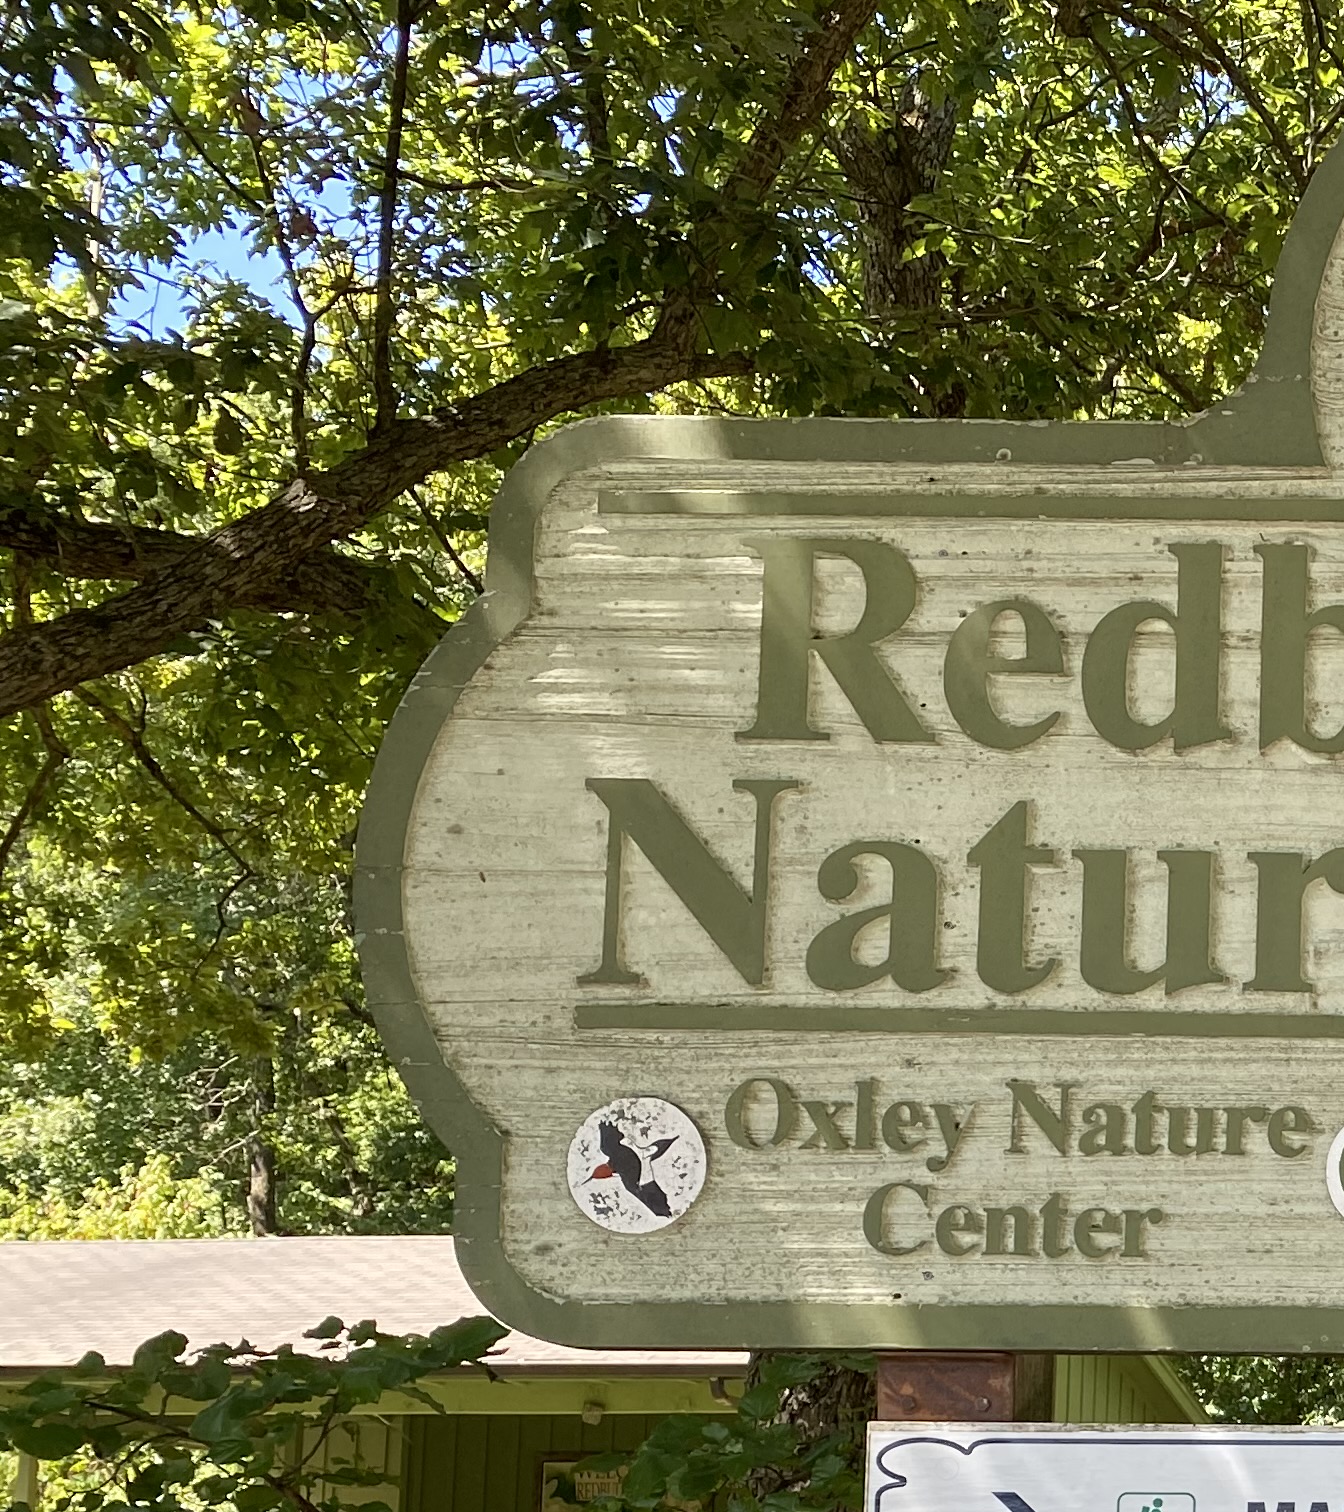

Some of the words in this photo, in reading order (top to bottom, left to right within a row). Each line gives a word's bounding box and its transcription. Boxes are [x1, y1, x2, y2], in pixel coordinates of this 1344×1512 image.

[722, 1077, 978, 1173] Oxley
[1004, 1079, 1315, 1159] Nature
[862, 1182, 1165, 1261] Center
